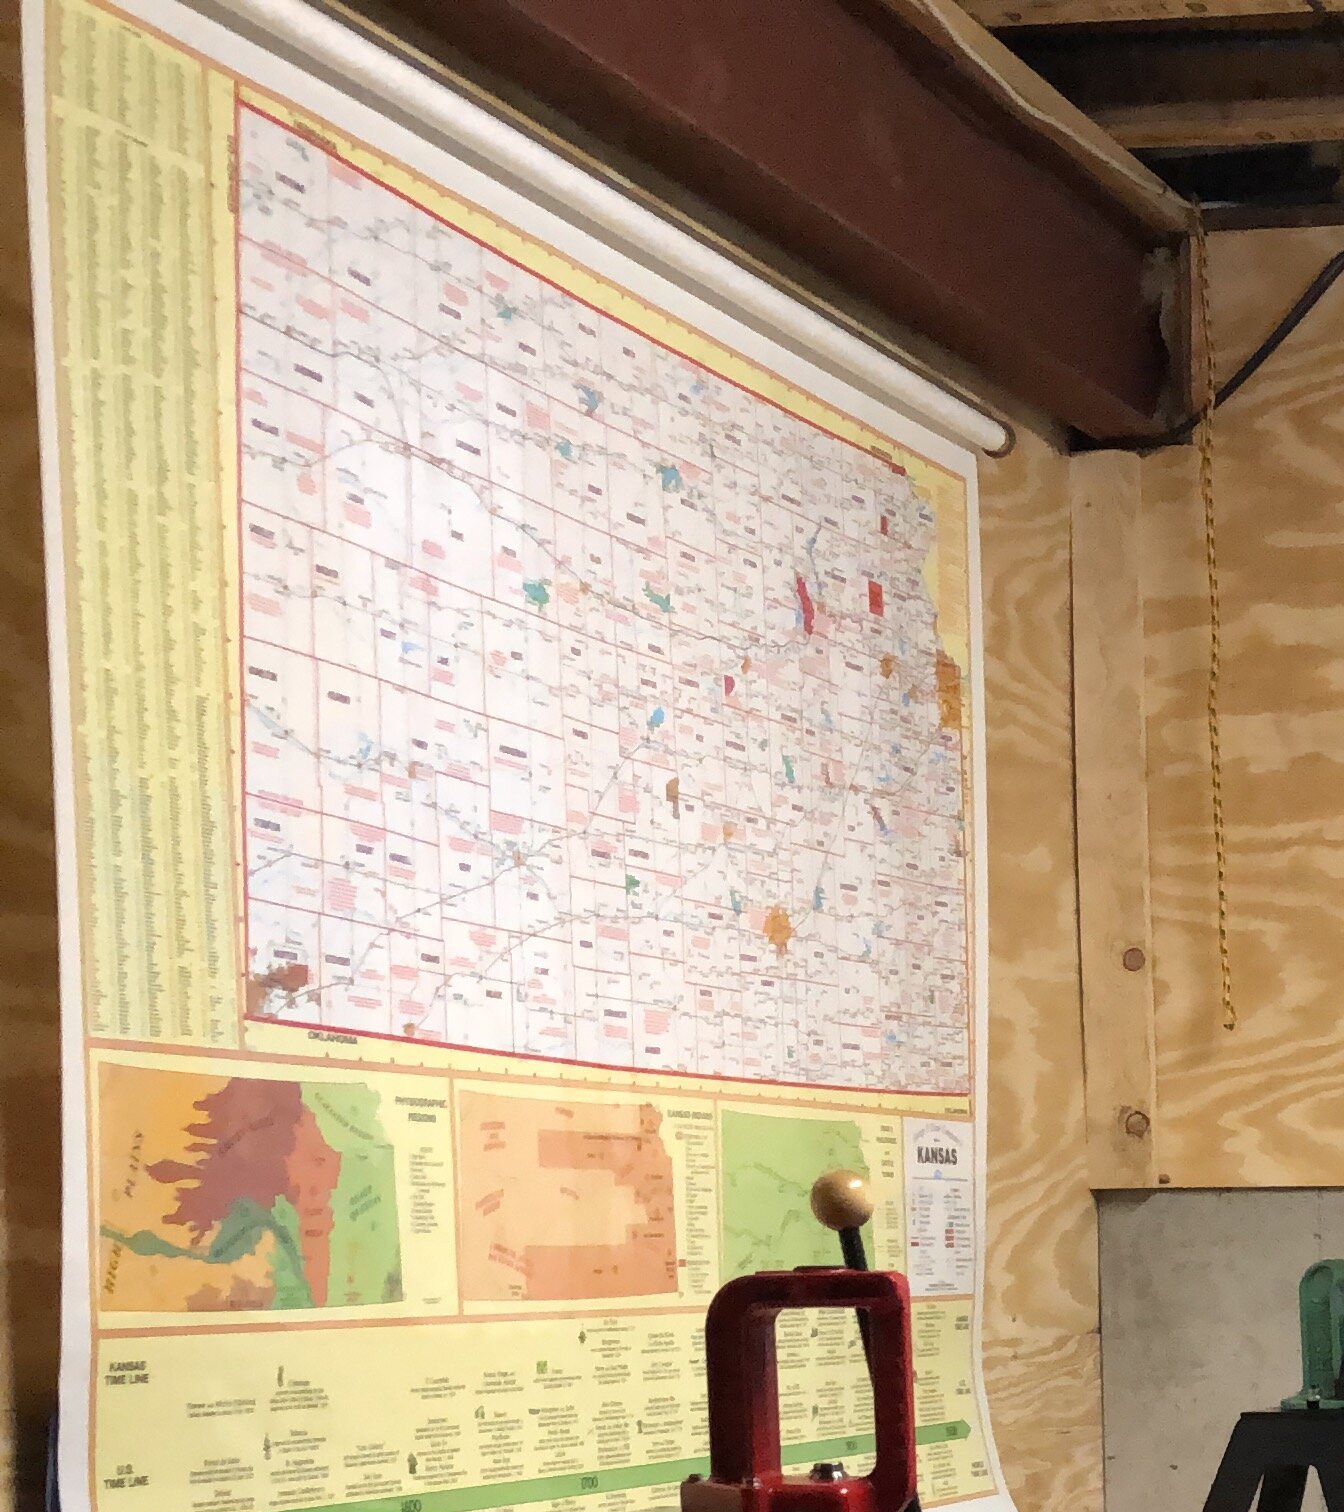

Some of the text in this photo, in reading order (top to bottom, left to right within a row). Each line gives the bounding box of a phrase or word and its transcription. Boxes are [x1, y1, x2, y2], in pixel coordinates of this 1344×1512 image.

[917, 1146, 958, 1165] KANSAS
[104, 1373, 150, 1385] TIME LINE
[104, 1476, 149, 1489] TIME LINE
